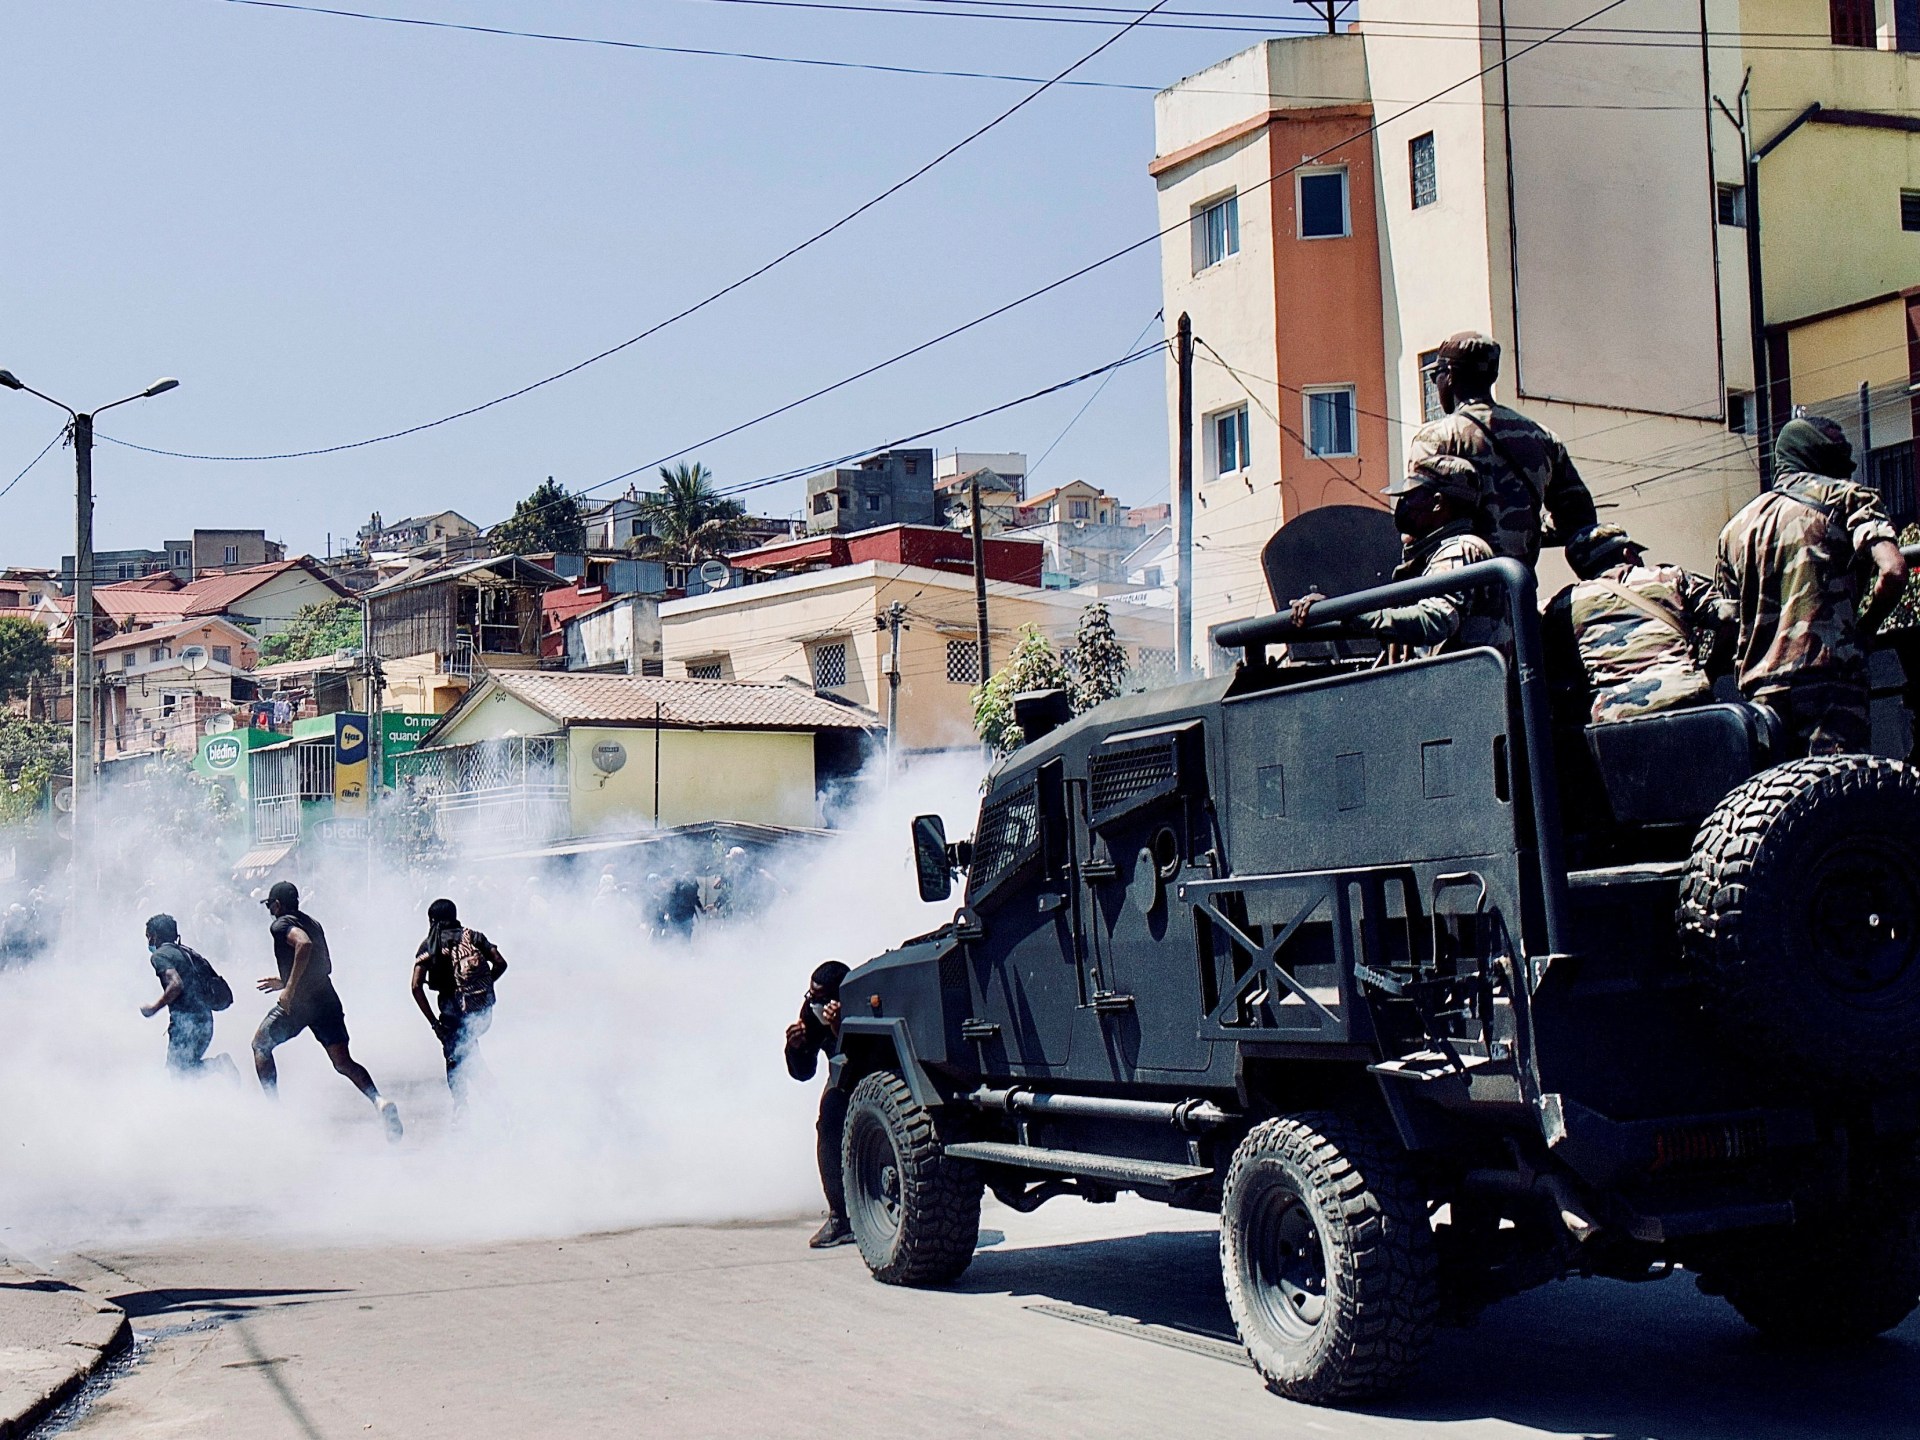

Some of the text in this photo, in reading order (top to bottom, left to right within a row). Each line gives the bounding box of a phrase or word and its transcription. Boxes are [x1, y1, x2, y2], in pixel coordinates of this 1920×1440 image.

[404, 716, 419, 727] On
[389, 730, 420, 743] quand
[210, 743, 237, 760] blédina
[342, 789, 360, 798] fibre
